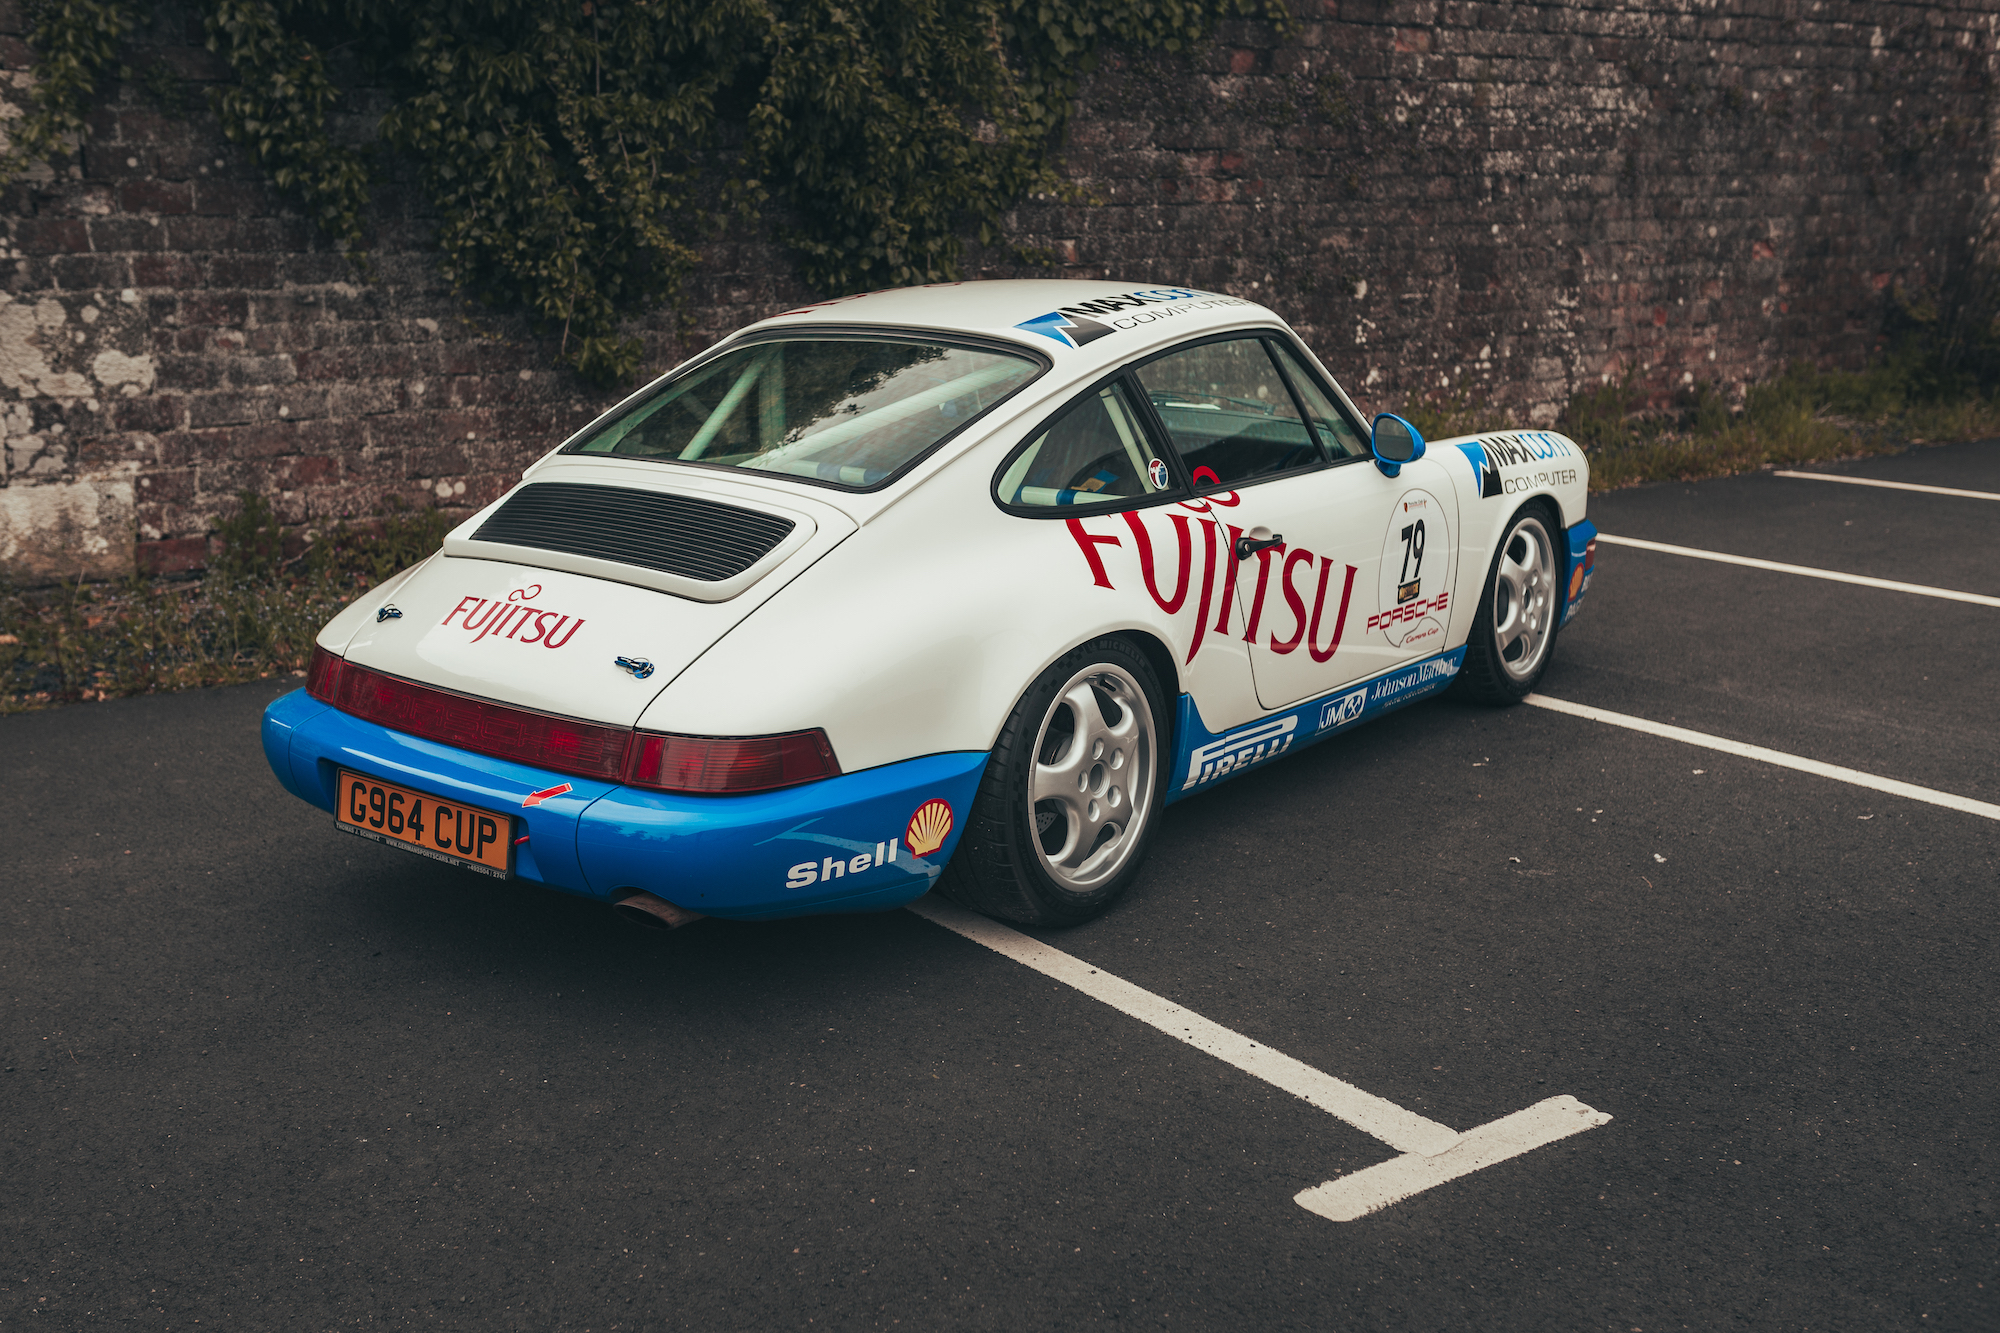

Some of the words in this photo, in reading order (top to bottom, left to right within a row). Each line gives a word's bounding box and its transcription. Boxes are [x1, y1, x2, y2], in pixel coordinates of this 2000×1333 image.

[1113, 299, 1256, 330] COMPUTER
[1504, 469, 1577, 495] COMPUTER
[1401, 518, 1425, 584] 79
[1066, 511, 1358, 667] FUJITSU
[441, 596, 586, 649] FUJITSU
[1366, 592, 1449, 634] PORSCHE
[1099, 640, 1147, 668] MICHELIN
[1405, 632, 1427, 644] Carrera
[1427, 627, 1439, 637] Cup
[1371, 672, 1420, 701] Johnson
[1321, 703, 1343, 729] JM
[1181, 714, 1298, 791] PIRELLI
[350, 782, 424, 841] G964
[434, 805, 497, 859] CUP
[785, 837, 898, 889] Shell
